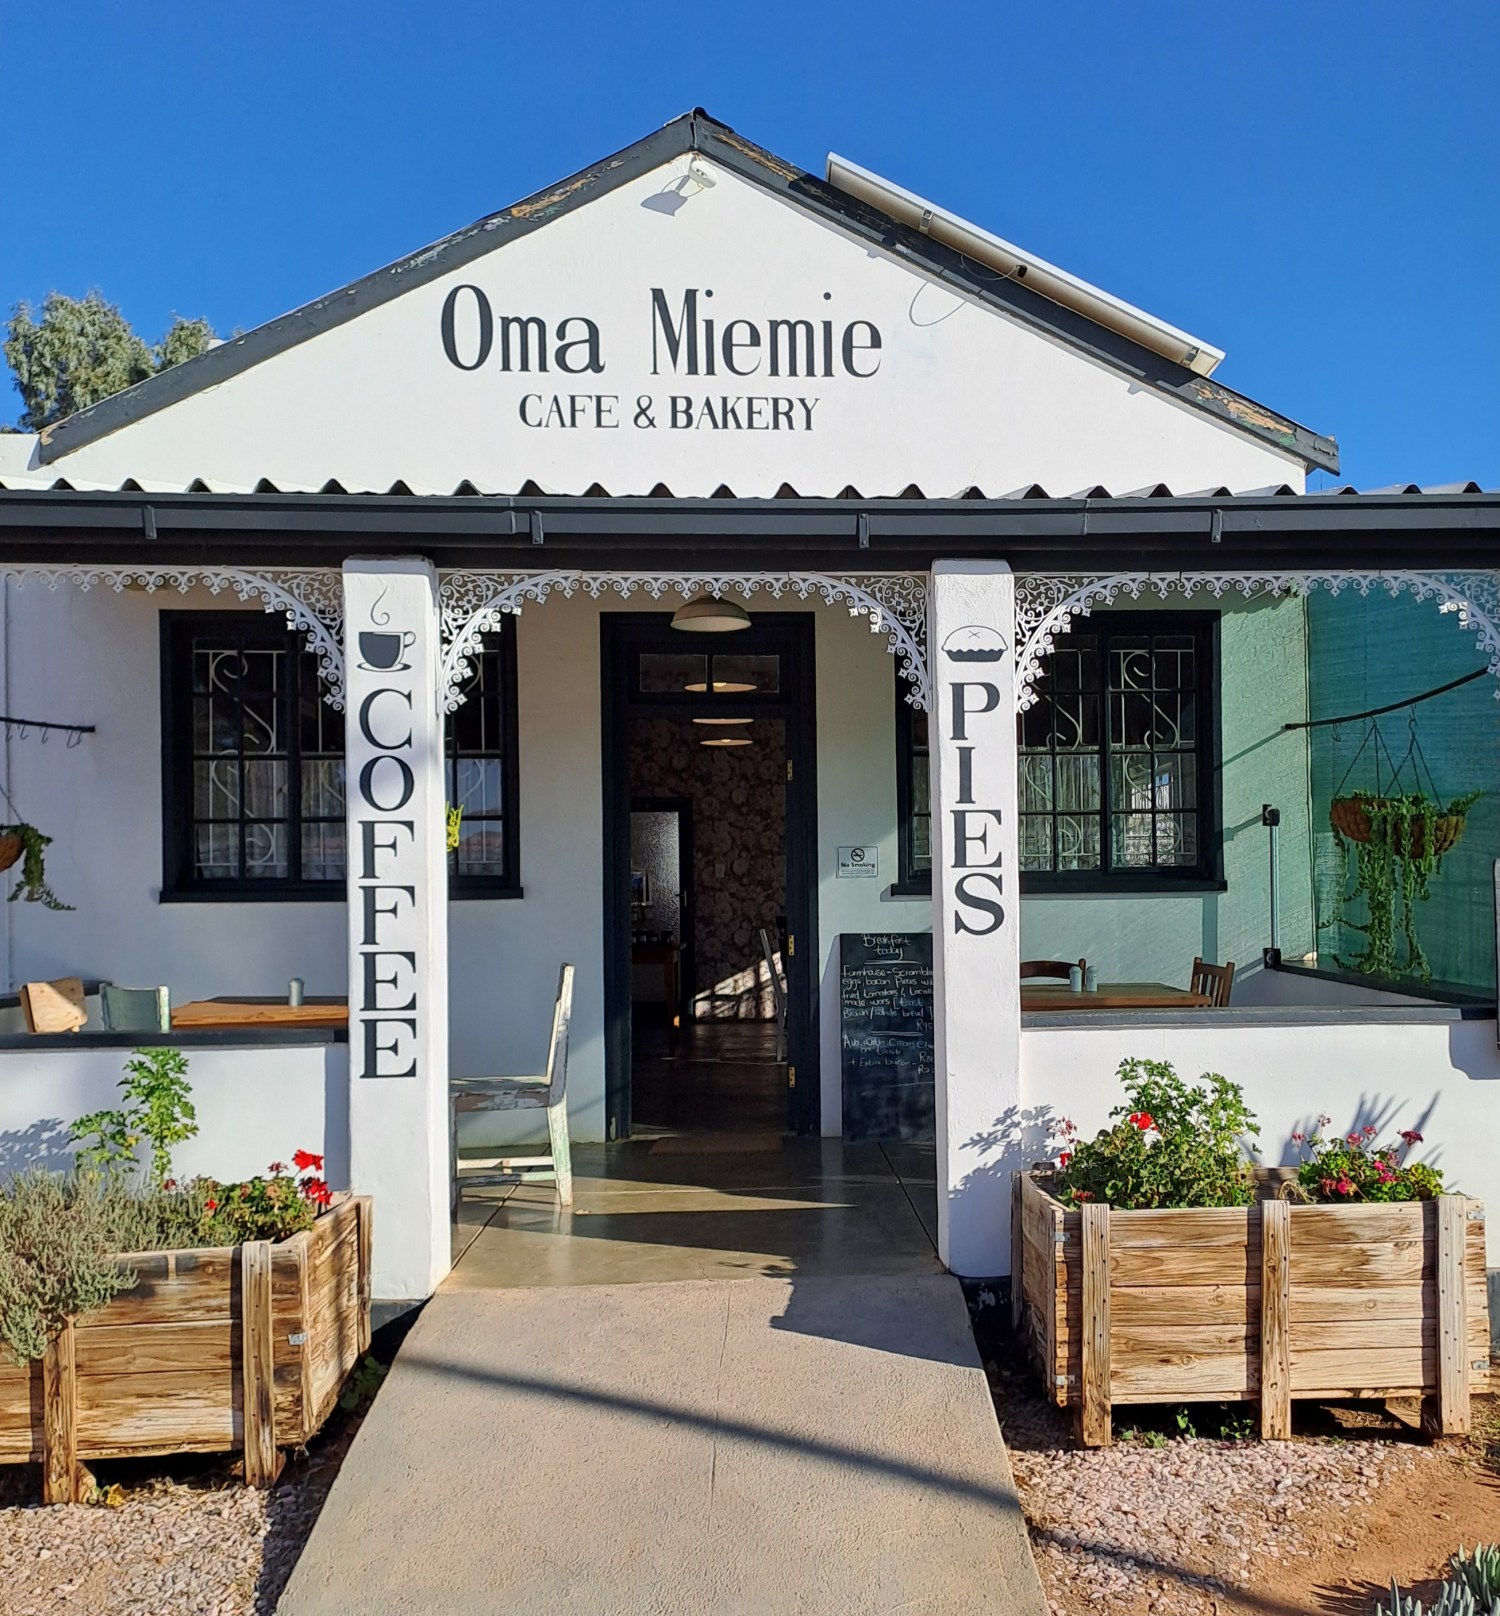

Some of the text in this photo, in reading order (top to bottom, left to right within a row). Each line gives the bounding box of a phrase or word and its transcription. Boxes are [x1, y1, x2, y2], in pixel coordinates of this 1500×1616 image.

[441, 284, 882, 378] Oma Miemie
[519, 394, 820, 431] CAFE & BAKERY
[948, 682, 1005, 936] PIES
[358, 688, 417, 1079] COFFEE
[862, 932, 911, 947] Breakfast
[873, 945, 904, 960] today
[865, 977, 891, 986] bacon
[844, 999, 866, 1007] made
